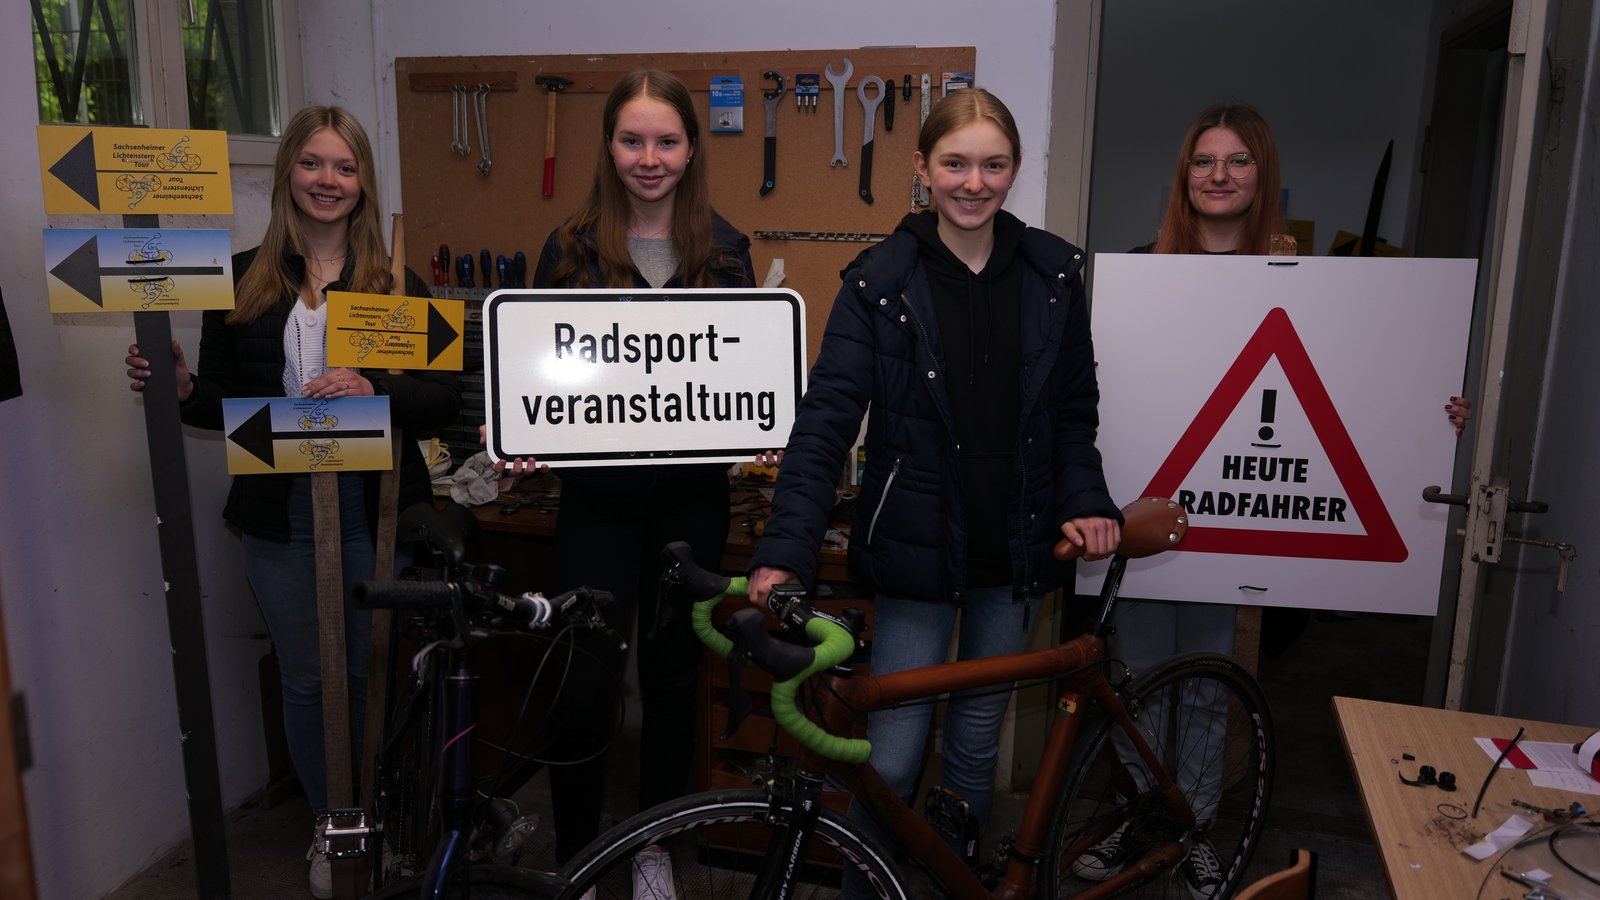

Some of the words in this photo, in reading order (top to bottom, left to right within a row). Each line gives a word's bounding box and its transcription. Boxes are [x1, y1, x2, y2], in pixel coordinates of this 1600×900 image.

[112, 152, 156, 160] Lichtenstern
[113, 143, 165, 151] Sachsenheimer
[349, 312, 382, 321] Lichtenstern
[350, 304, 391, 314] Sachsenheimer
[554, 322, 740, 374] Radsport-
[522, 381, 776, 432] veranstaltung
[1222, 455, 1309, 483] HEUTE
[1177, 489, 1347, 523] RADFAHRER
[785, 829, 804, 880] CARBON
